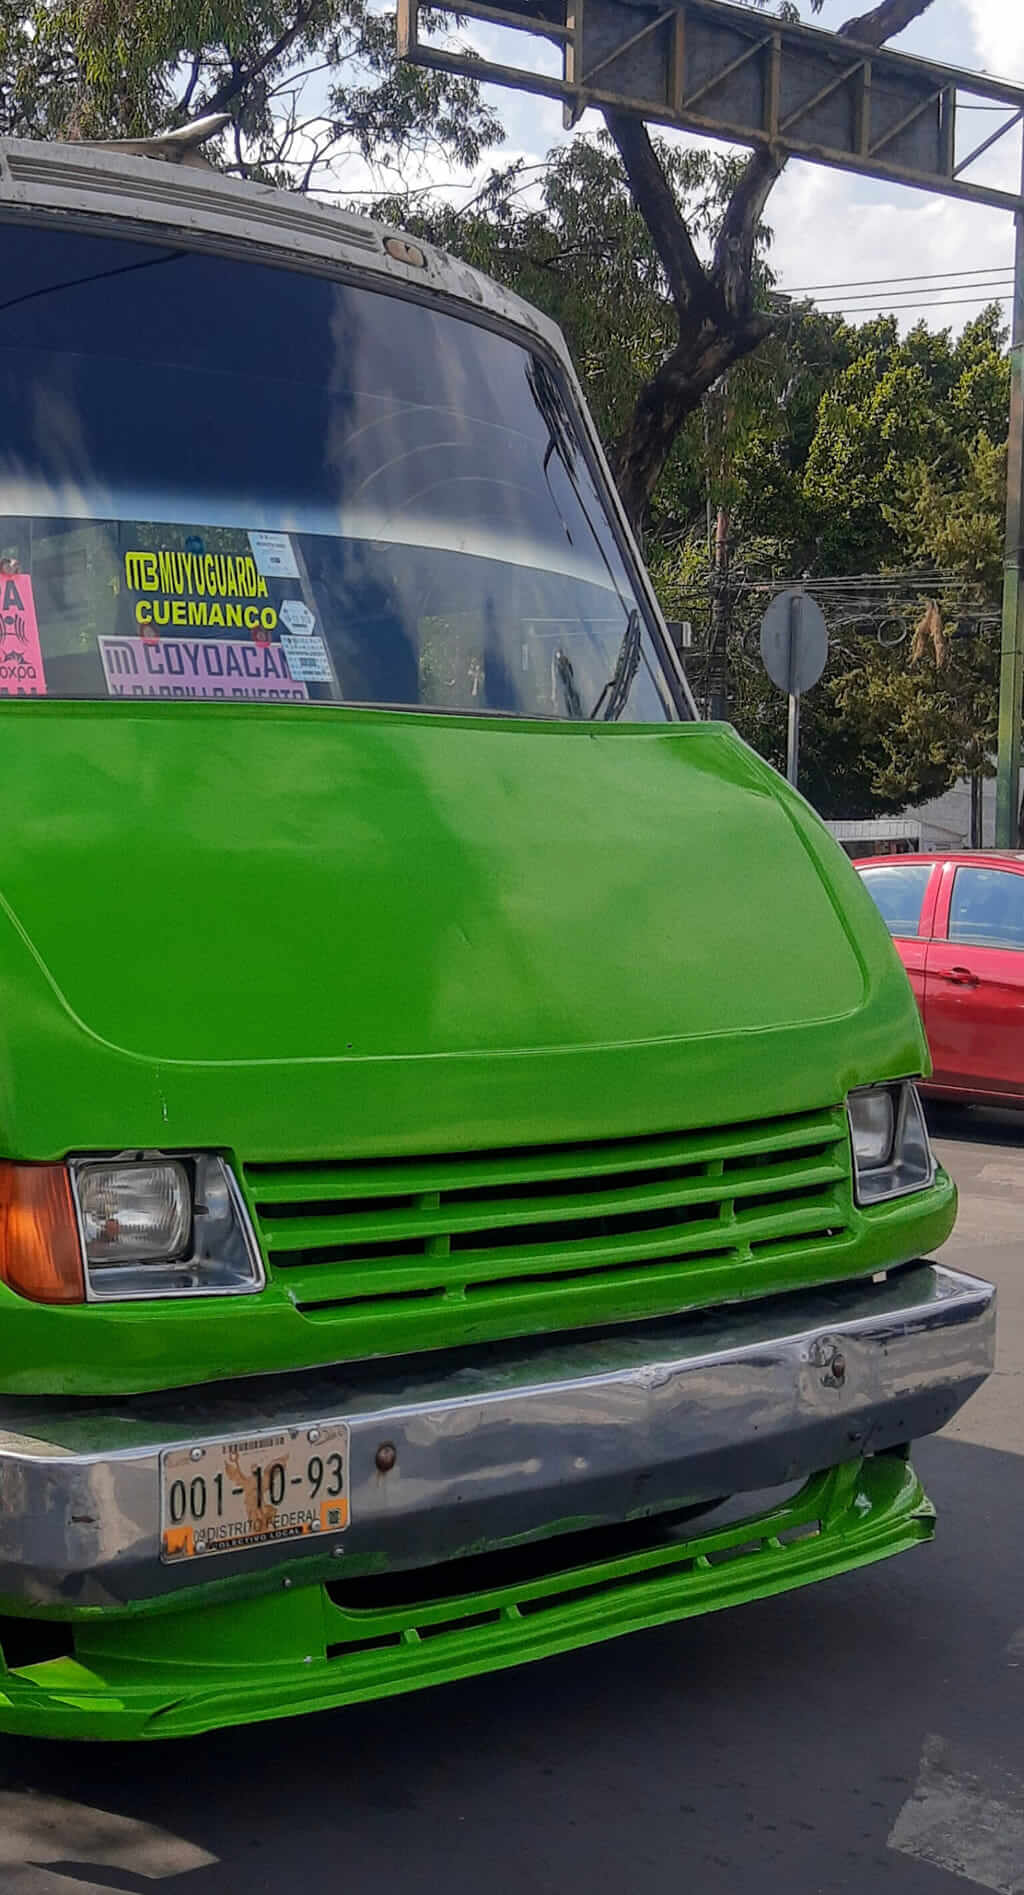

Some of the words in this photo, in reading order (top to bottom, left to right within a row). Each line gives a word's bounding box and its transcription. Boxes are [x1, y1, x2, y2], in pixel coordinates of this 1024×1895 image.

[135, 600, 278, 630] CUEMANCO
[169, 1453, 344, 1525] 001-10-93
[265, 1508, 320, 1533] FEDERAL
